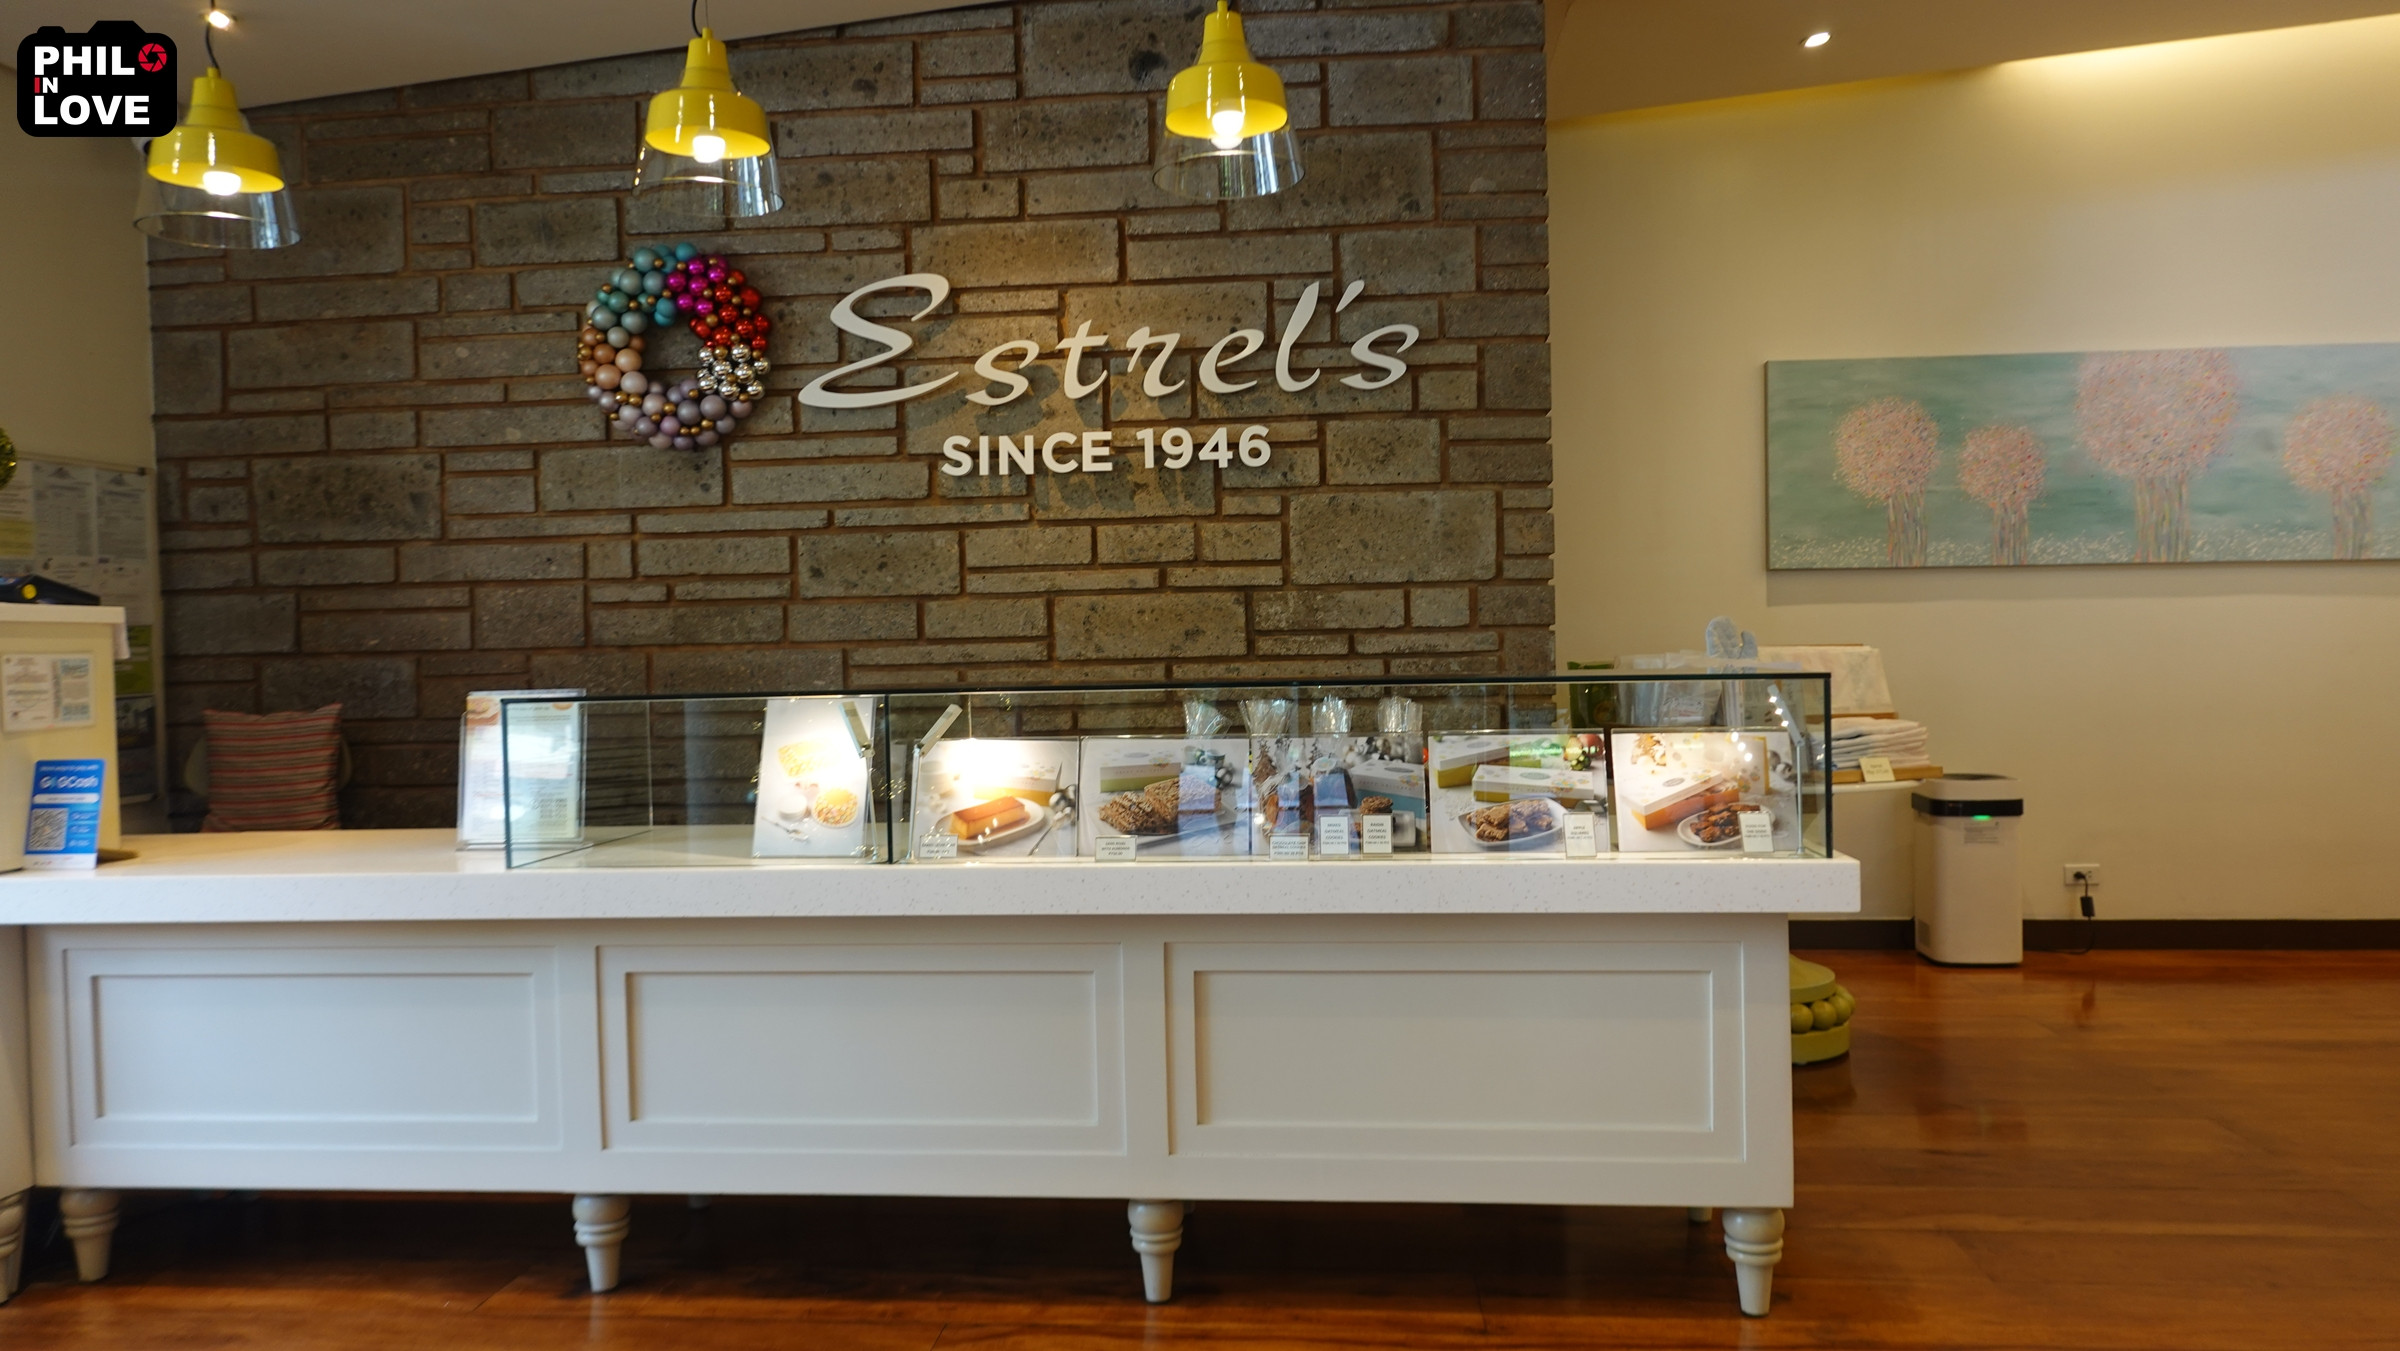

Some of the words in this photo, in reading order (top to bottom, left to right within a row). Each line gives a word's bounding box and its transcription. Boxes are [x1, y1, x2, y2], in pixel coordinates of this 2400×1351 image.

[798, 272, 1421, 410] Estrel's
[940, 430, 1113, 478] SINCE
[1135, 424, 1272, 470] 1946
